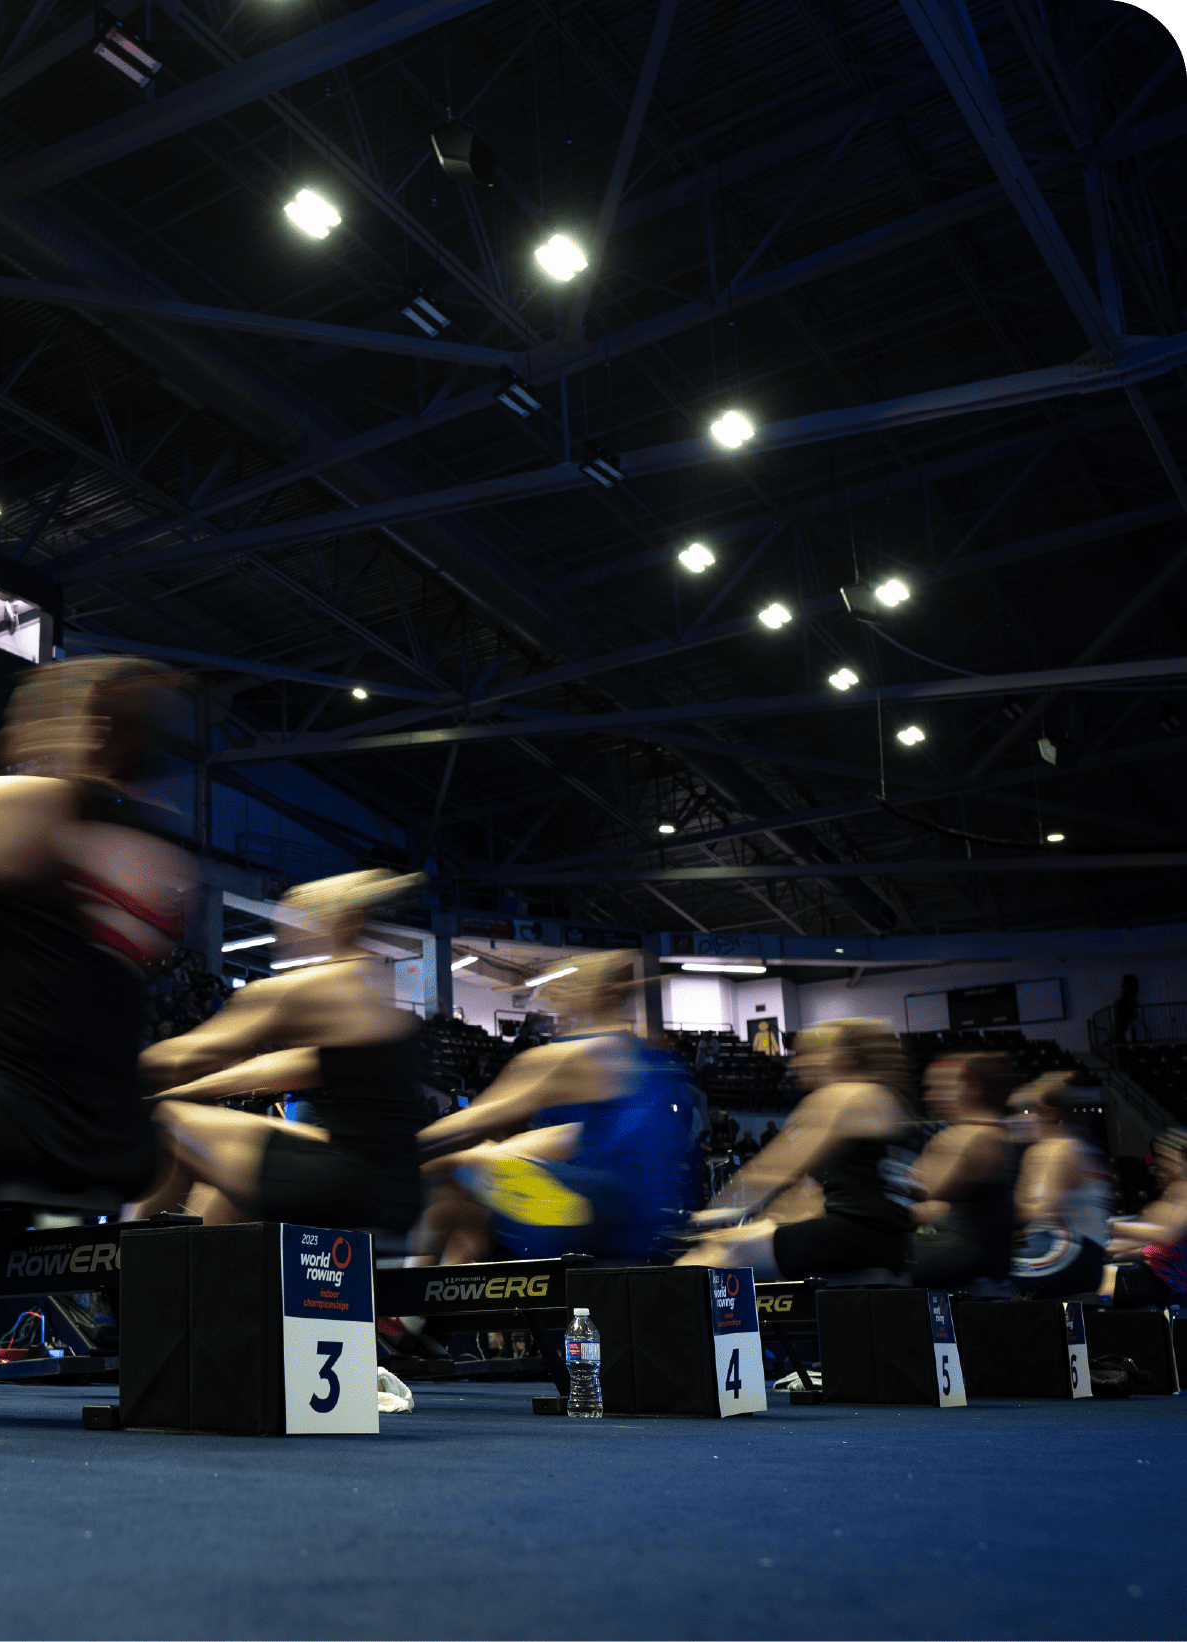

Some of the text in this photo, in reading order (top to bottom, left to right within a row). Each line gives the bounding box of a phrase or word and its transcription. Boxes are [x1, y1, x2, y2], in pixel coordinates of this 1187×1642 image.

[301, 1233, 319, 1246] 2023
[5, 1242, 122, 1278] RowER
[300, 1251, 331, 1269] world
[306, 1267, 343, 1288] rowing
[303, 1297, 350, 1313] championships
[319, 1287, 341, 1299] indoor
[309, 1340, 344, 1414] 3
[725, 1348, 742, 1400] 4
[942, 1355, 951, 1396] 5
[1070, 1353, 1079, 1389] 6
